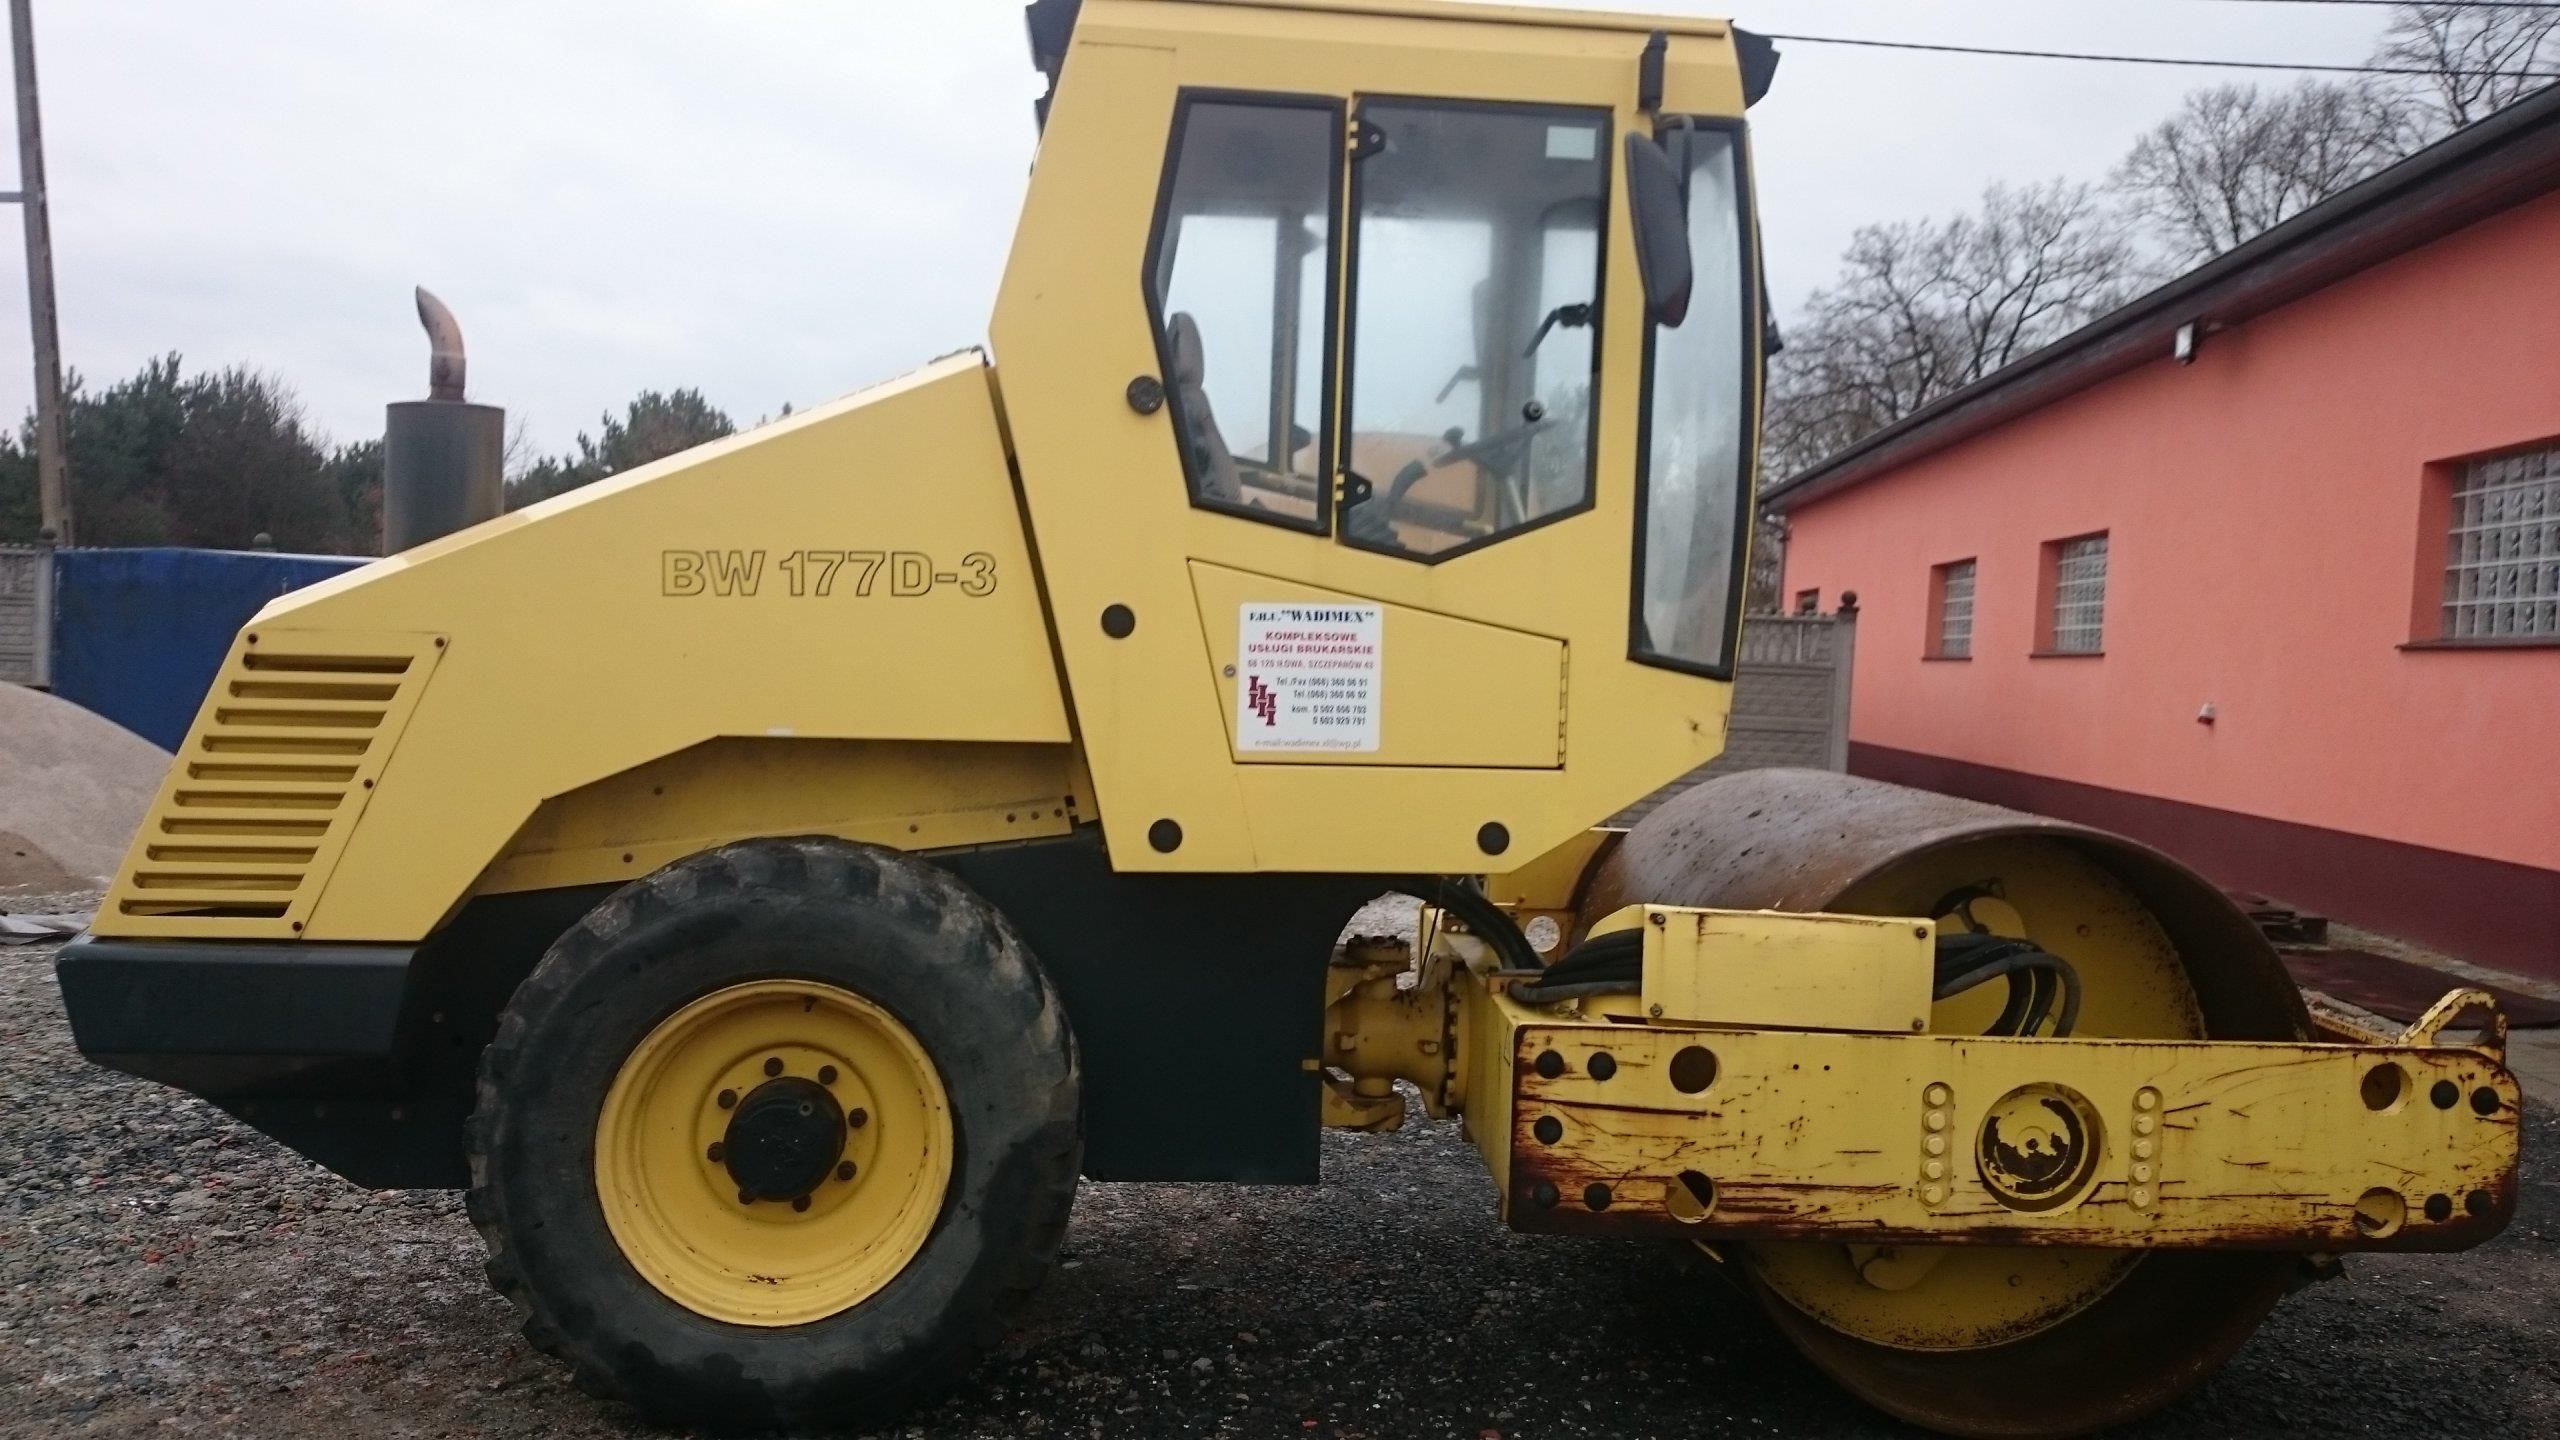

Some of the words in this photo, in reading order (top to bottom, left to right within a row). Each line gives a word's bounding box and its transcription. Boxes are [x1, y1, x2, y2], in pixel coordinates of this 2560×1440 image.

[662, 549, 766, 597] BW
[779, 549, 998, 598] 177D-3
[1265, 631, 1358, 642] KOMPLEKSOWE
[1248, 643, 1293, 653] USŁUGI
[1296, 644, 1374, 655] BRUKARSKIE
